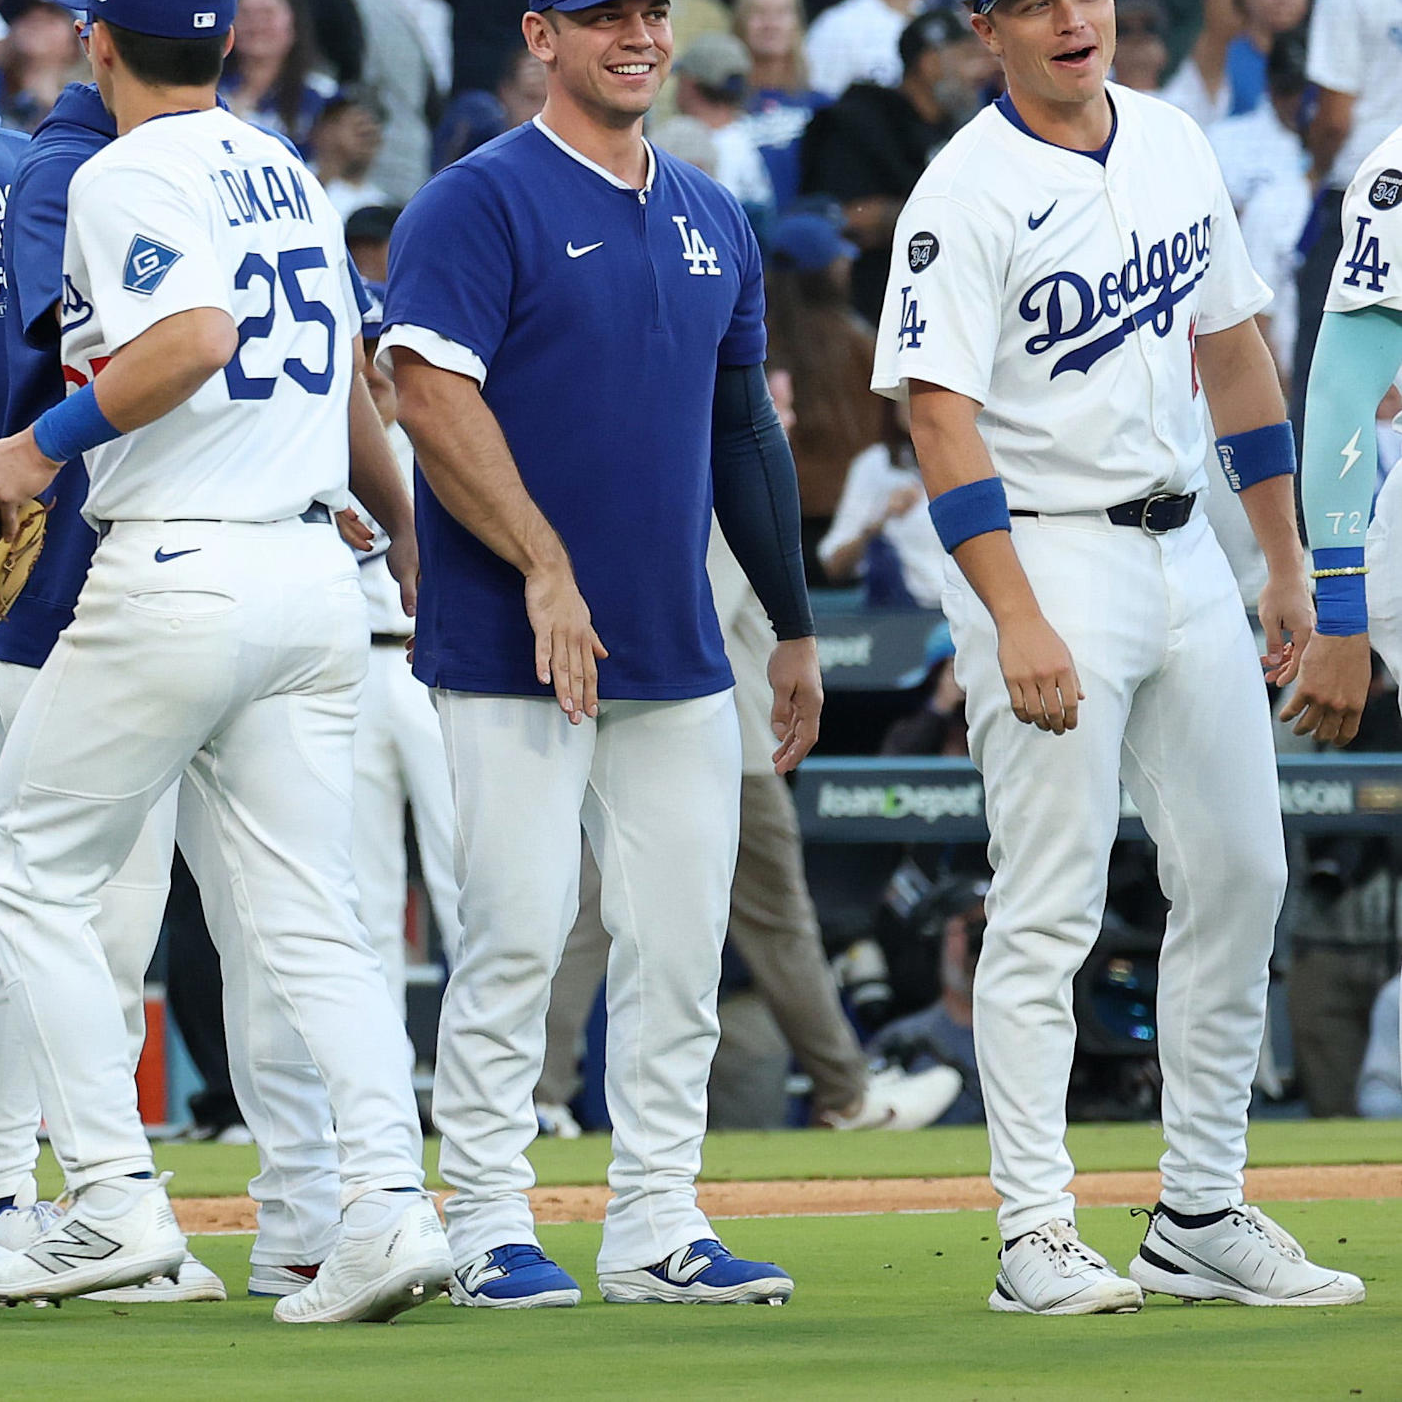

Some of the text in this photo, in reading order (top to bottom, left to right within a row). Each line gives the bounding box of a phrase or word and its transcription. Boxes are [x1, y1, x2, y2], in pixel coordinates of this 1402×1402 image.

[1372, 181, 1400, 205] 34
[672, 215, 722, 276] LA
[1342, 215, 1391, 293] LA
[224, 247, 337, 401] 25
[1325, 511, 1362, 535] 72
